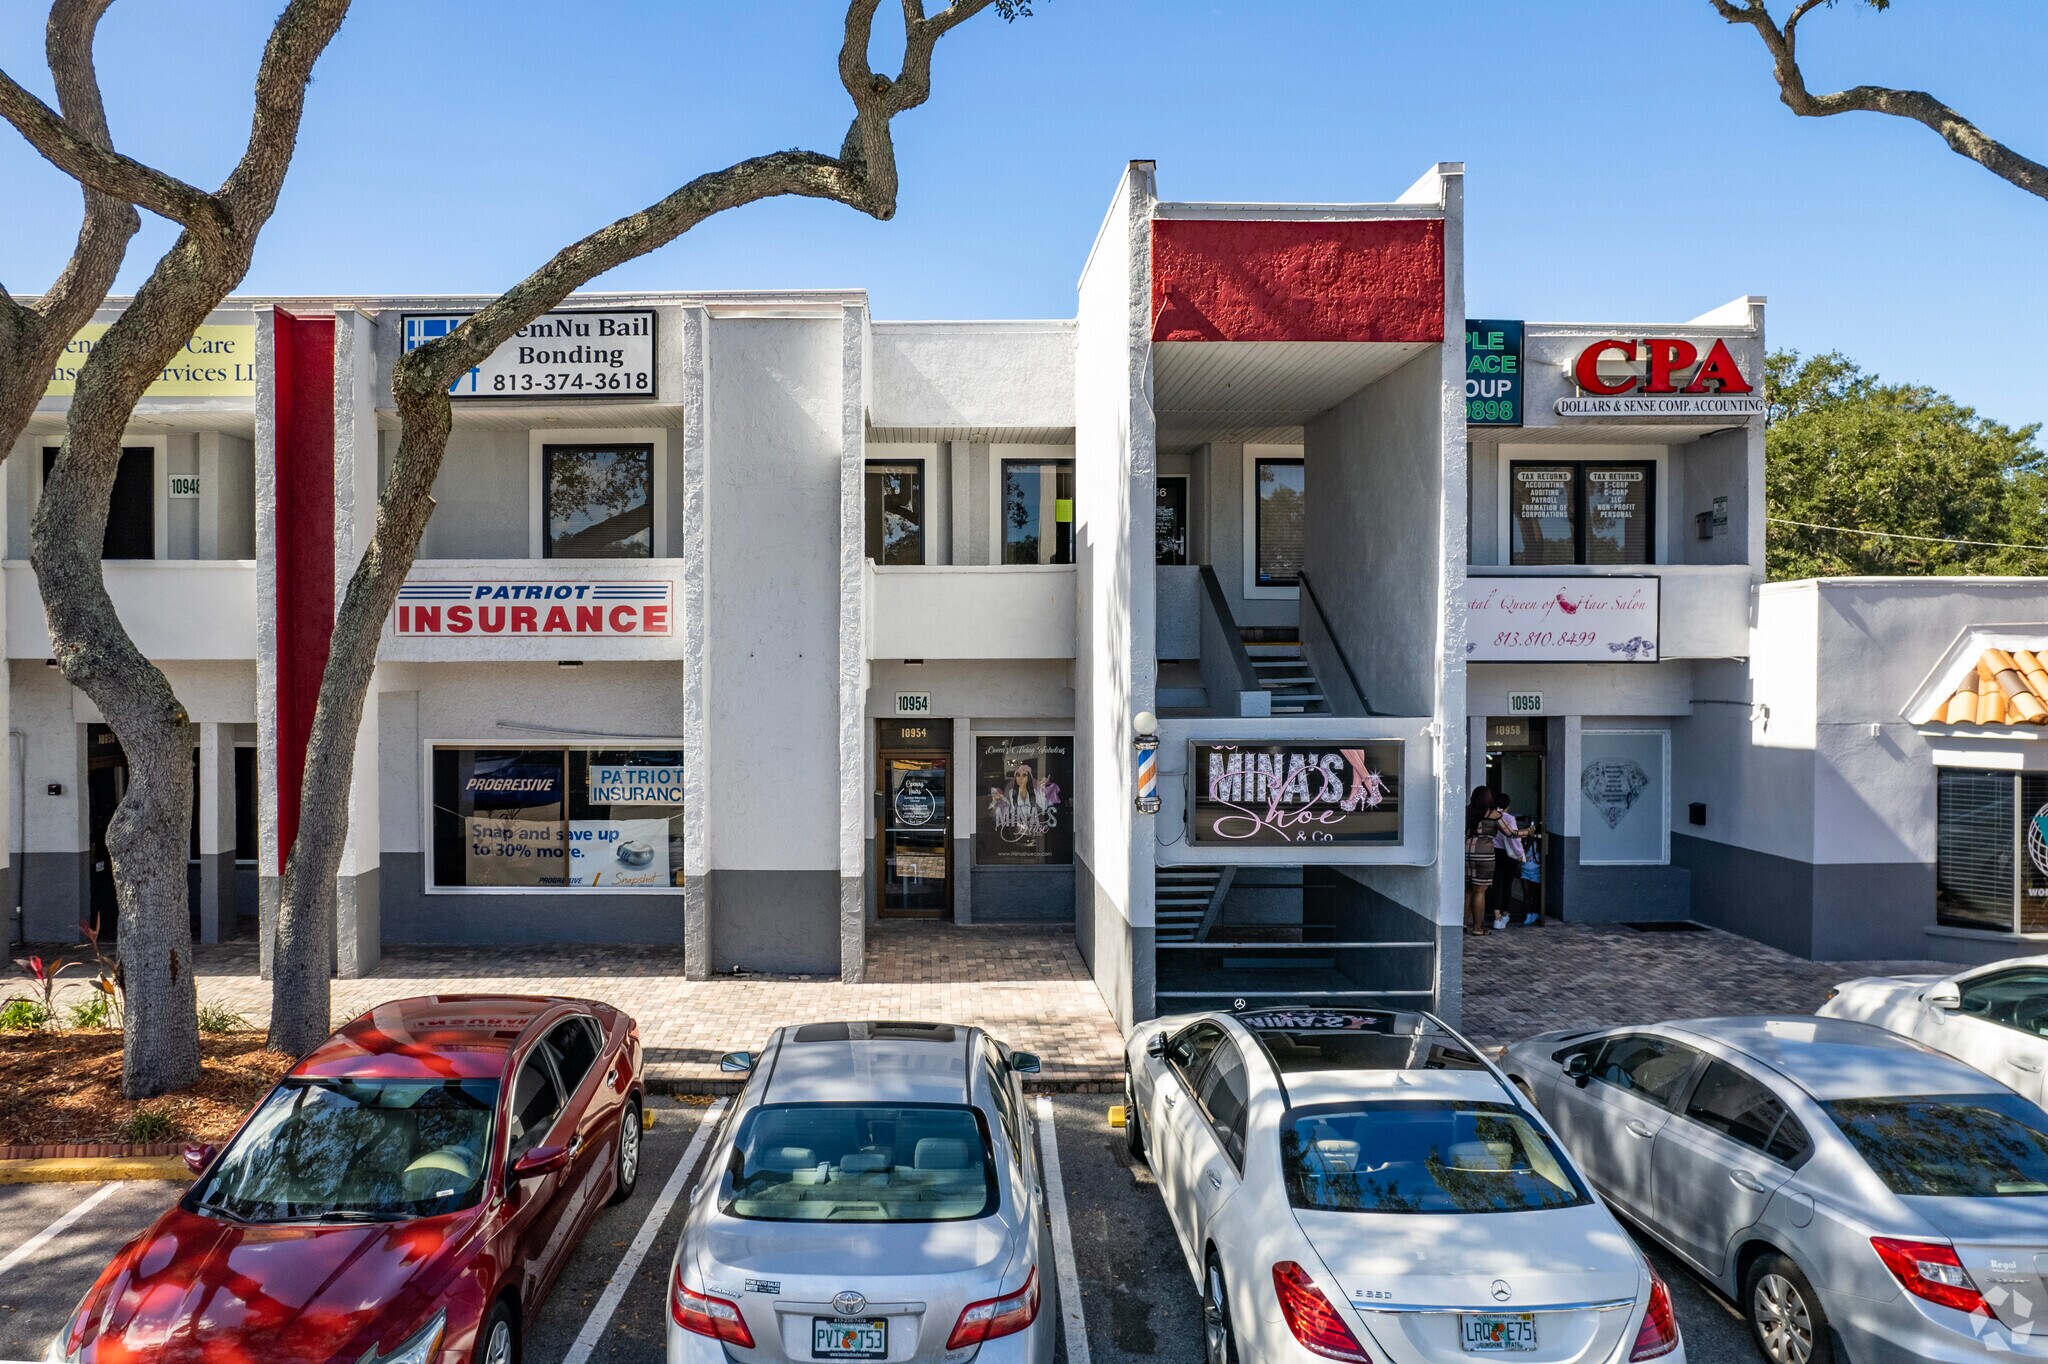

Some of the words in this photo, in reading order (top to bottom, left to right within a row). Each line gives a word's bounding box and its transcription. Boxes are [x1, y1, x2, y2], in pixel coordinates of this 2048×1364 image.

[599, 317, 649, 336] Bail
[185, 336, 236, 354] Care
[518, 345, 625, 368] Bonding
[155, 364, 227, 382] rvices
[1575, 338, 1753, 395] CPA
[493, 372, 649, 391] 813-374-3618
[1561, 400, 1611, 413] DOLLARS
[1613, 400, 1622, 412] &
[1624, 399, 1656, 412] SENSE
[1658, 399, 1691, 412] COMP.
[1693, 399, 1764, 412] ACCOUNTING
[1525, 481, 1564, 489] ACCOUNTING
[1603, 481, 1629, 489] S-CORP
[1597, 503, 1636, 511] NON-PROFIT
[475, 585, 591, 600] PATRIOT
[1500, 594, 1537, 614] Queen
[1575, 594, 1608, 610] Hair
[1611, 589, 1646, 610] Salon
[399, 605, 668, 633] INSURANCE
[1494, 631, 1596, 647] 813.810.8499
[898, 696, 928, 710] 10954
[1511, 695, 1541, 710] 10958
[901, 728, 927, 738] 10954
[1495, 725, 1521, 735] 10958
[600, 769, 684, 784] PATRIOT
[1208, 753, 1344, 803] MINA'S
[465, 778, 555, 791] PROGRESSIVE
[593, 787, 684, 802] INSURANC
[1209, 766, 1347, 841] Shoe
[472, 824, 513, 841] Snap
[519, 826, 550, 841] and
[556, 829, 592, 841] save
[598, 829, 620, 843] up
[1296, 830, 1307, 841] &
[472, 843, 491, 856] to
[495, 843, 532, 858] 30%
[536, 846, 585, 858] moe.
[611, 872, 665, 886] Snapshot
[1990, 1259, 2017, 1270] Regal
[817, 1329, 841, 1348] PVI
[858, 1329, 882, 1348] T53
[1465, 1322, 1491, 1342] LRQ
[1506, 1321, 1532, 1341] E75
